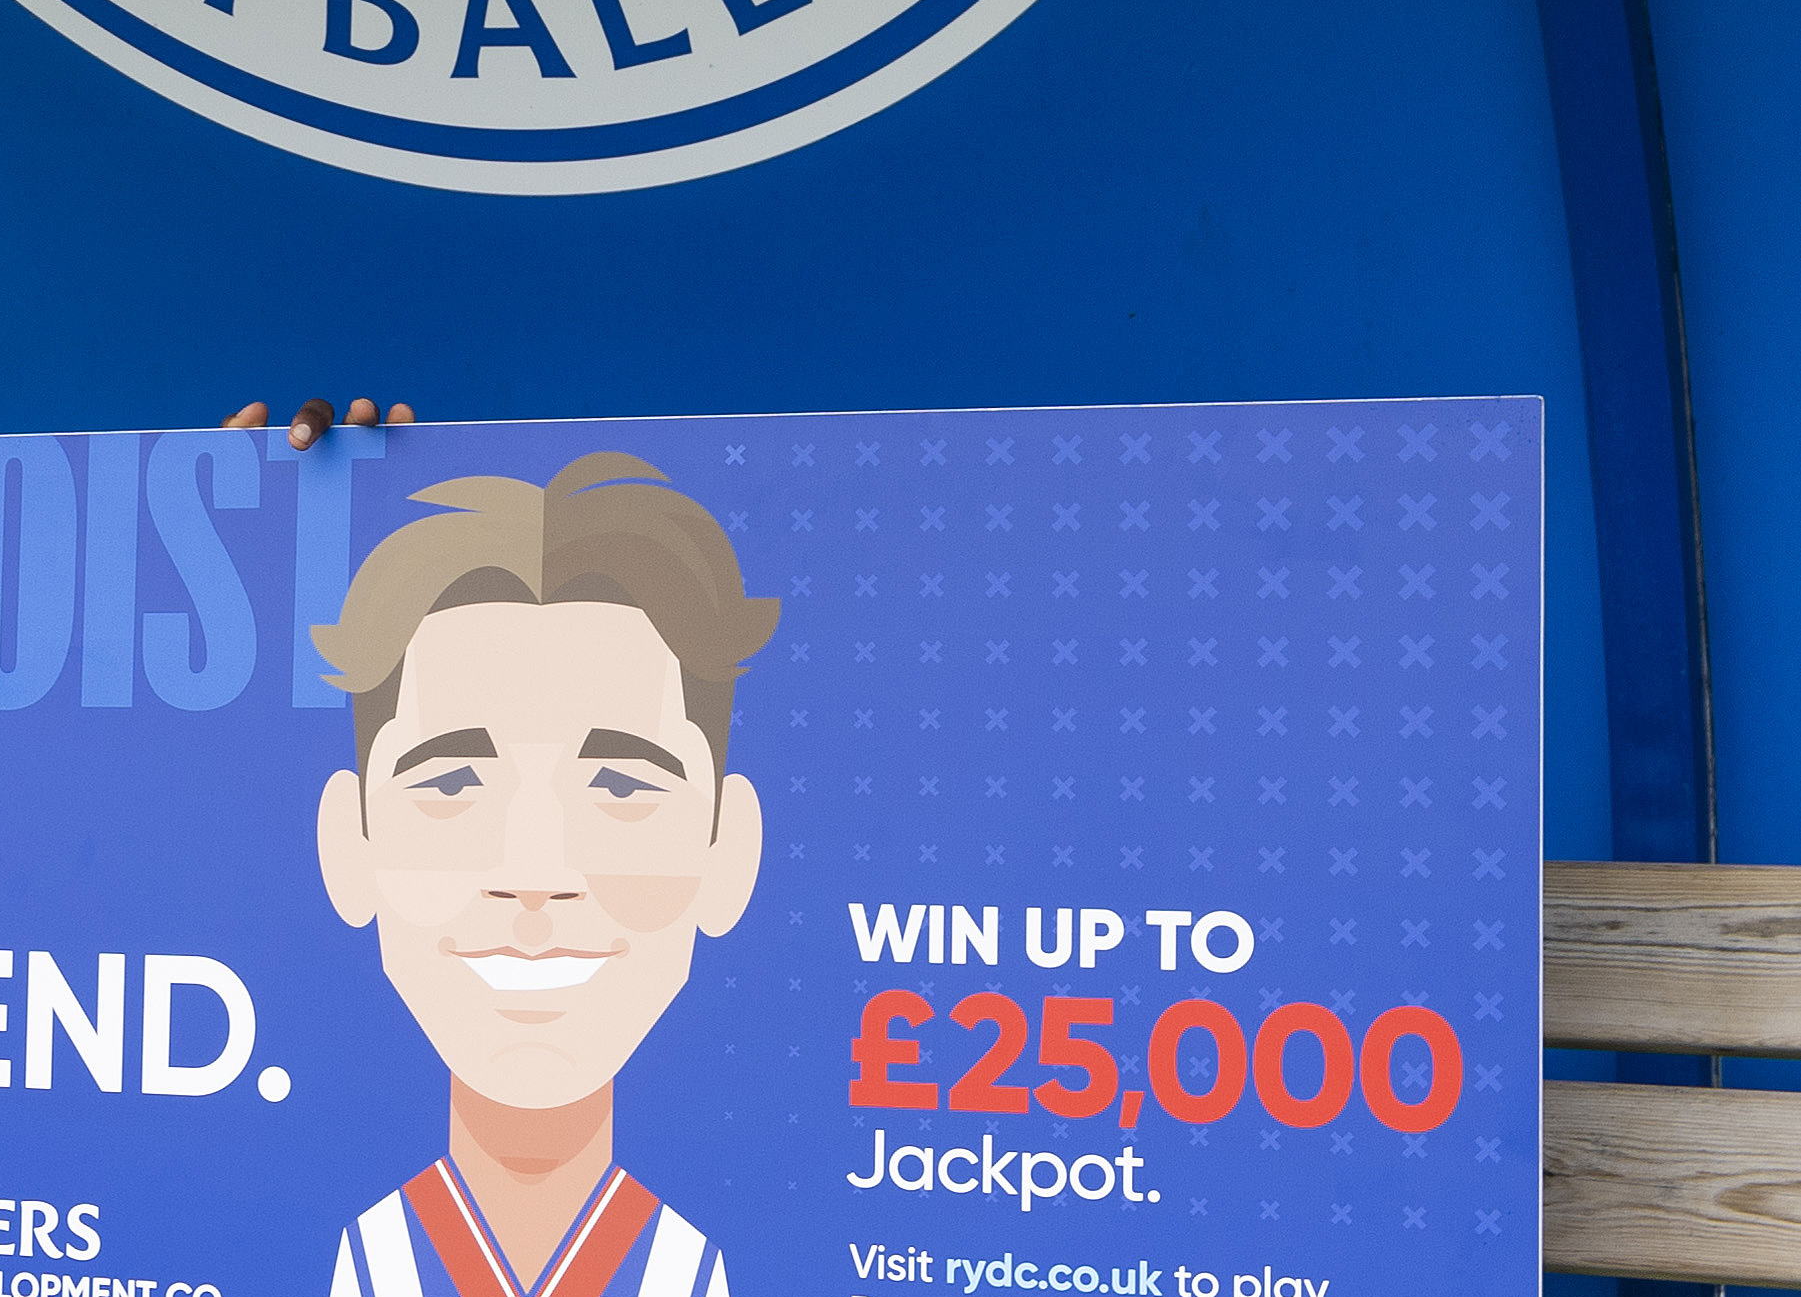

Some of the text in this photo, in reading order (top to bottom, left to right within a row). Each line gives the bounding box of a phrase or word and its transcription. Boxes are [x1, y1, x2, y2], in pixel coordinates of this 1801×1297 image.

[847, 902, 1256, 974] WIN UP TO
[847, 988, 1464, 1134] £25,000
[845, 1129, 1162, 1212] Jackpot.
[848, 1243, 934, 1284] Visit
[945, 1252, 1163, 1297] rydc.co.uk
